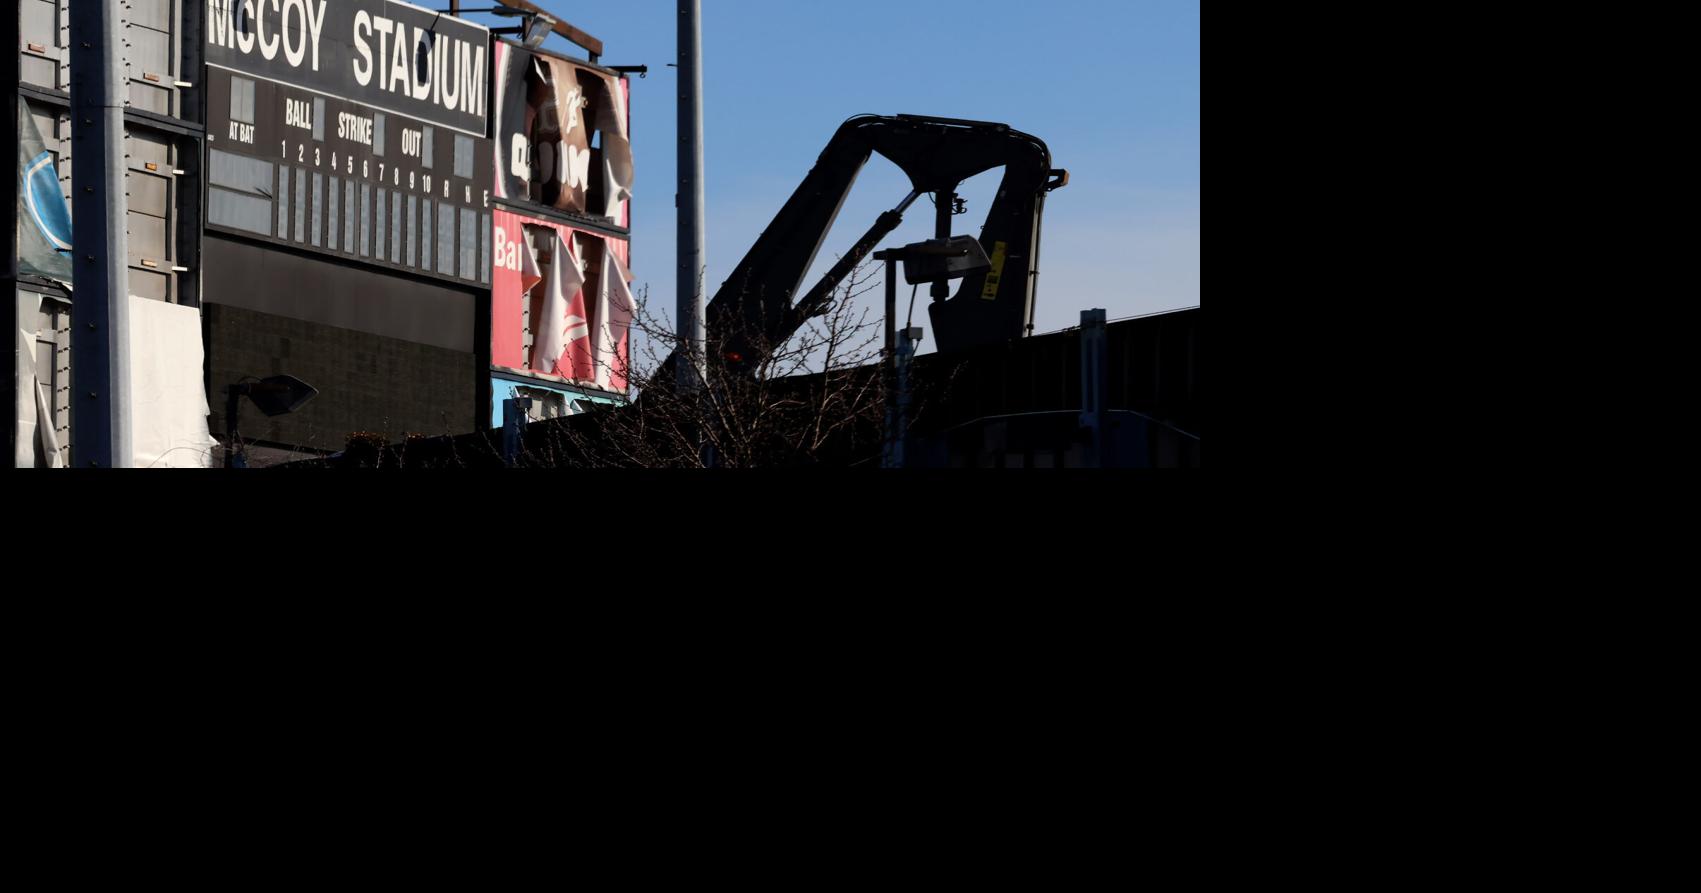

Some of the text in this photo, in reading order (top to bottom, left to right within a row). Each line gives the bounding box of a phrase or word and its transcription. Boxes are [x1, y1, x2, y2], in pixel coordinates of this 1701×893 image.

[353, 9, 485, 117] STADIUM
[286, 98, 311, 129] BALL
[338, 111, 372, 146] STRIKE
[229, 120, 255, 145] AT BAT
[402, 128, 421, 158] OUT
[281, 139, 489, 208] 1 2 3 4 5 6 7 8 9 10 R H E
